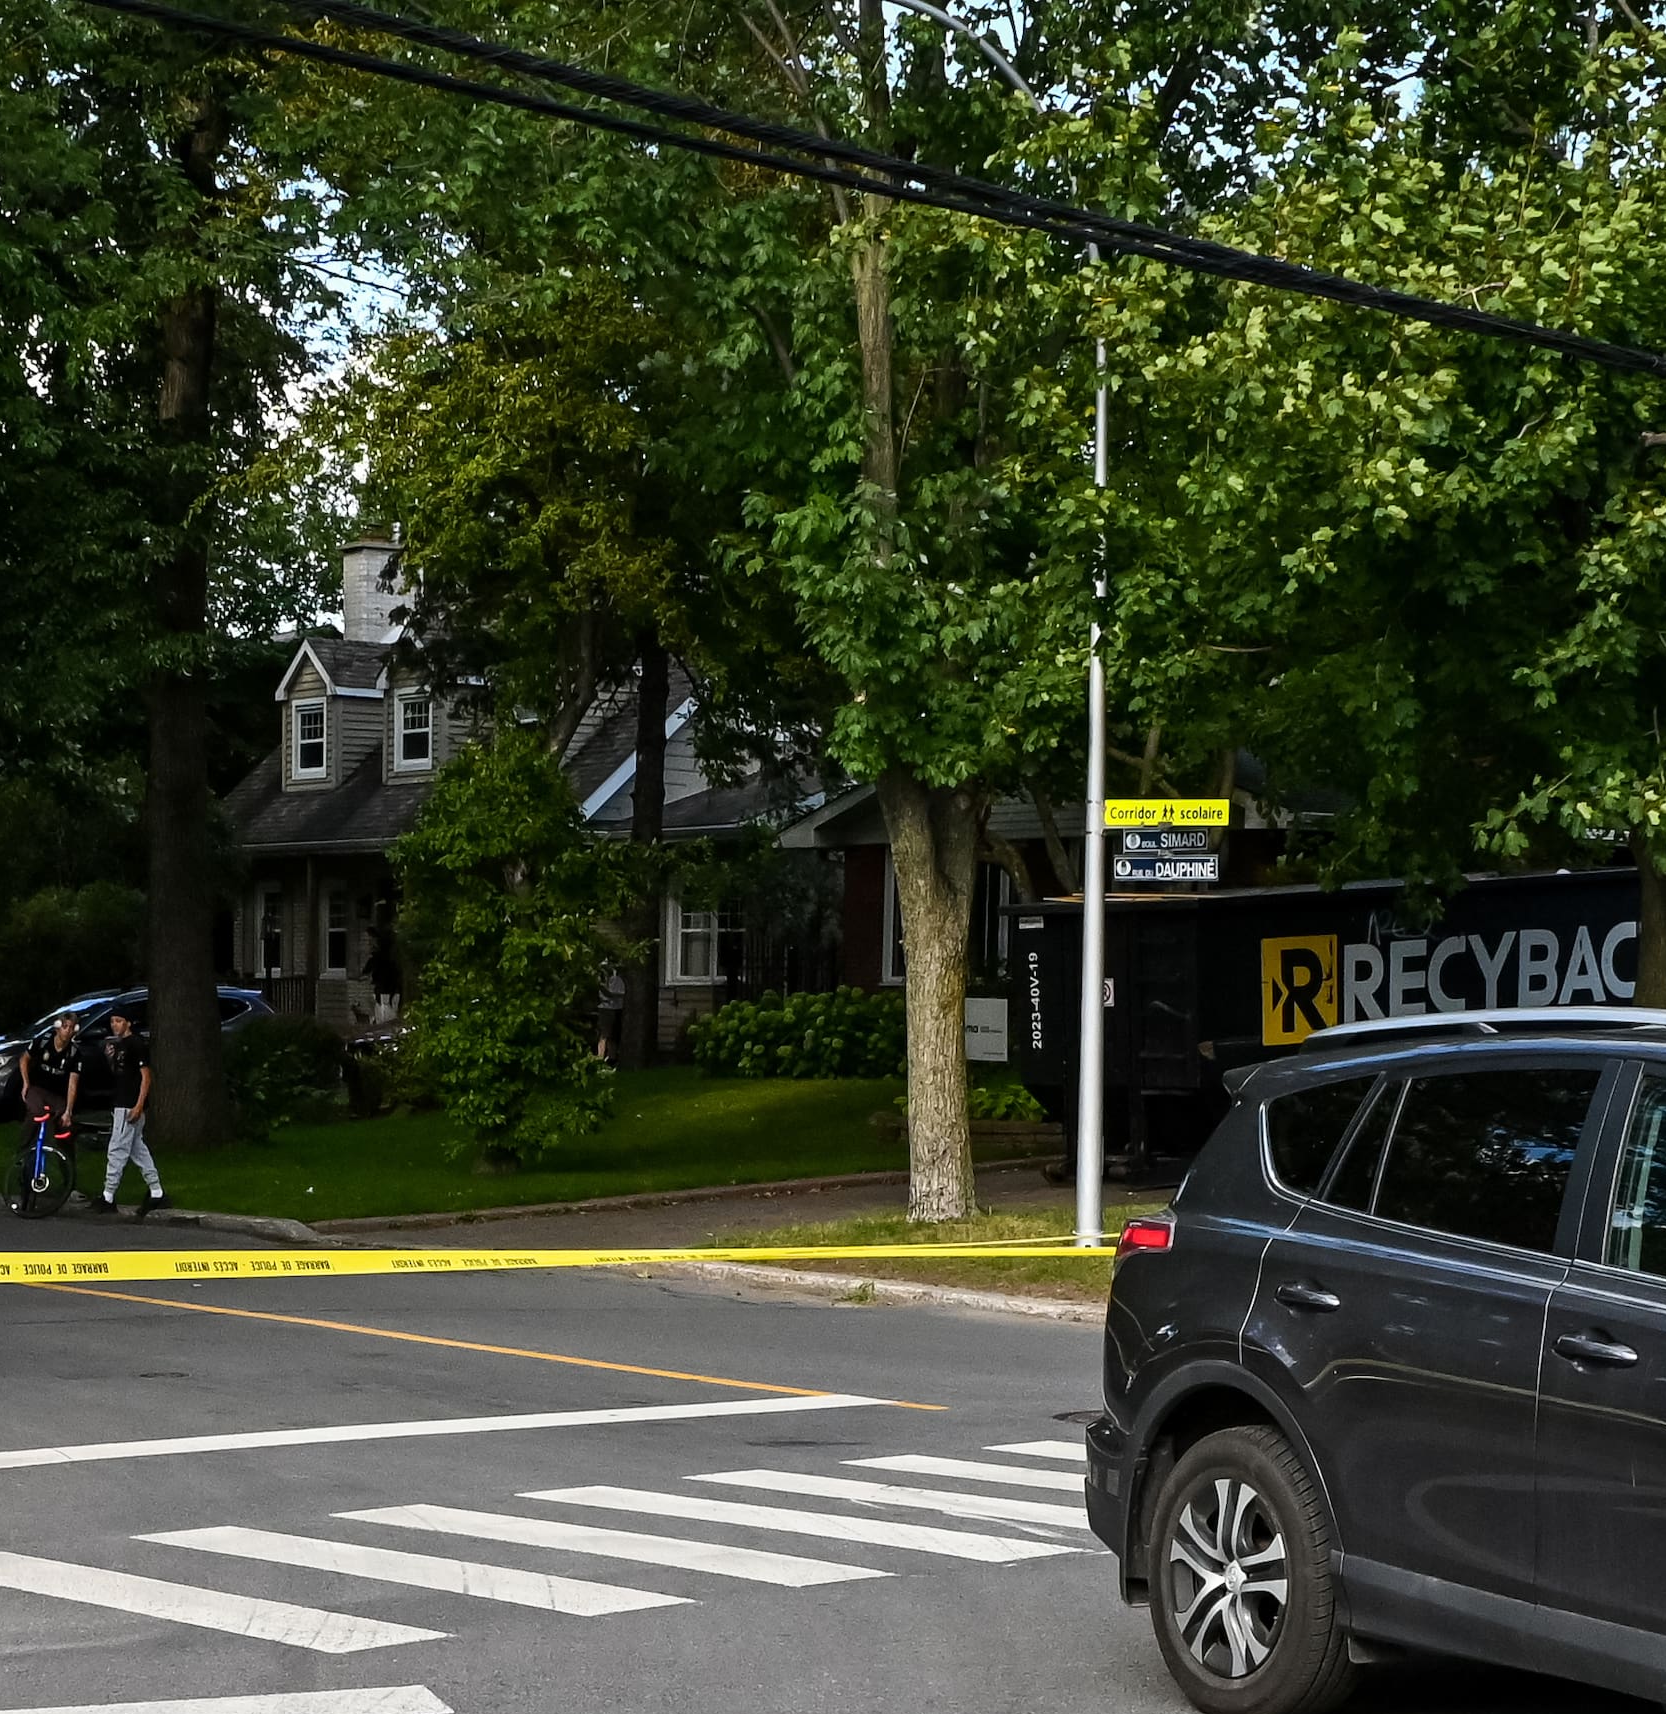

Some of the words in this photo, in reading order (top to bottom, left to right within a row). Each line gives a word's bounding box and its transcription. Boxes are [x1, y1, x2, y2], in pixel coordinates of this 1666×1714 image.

[1110, 805, 1157, 820] Corridor
[1180, 806, 1223, 820] scolaire
[1160, 832, 1206, 848] SIMARD
[1155, 857, 1215, 877] DAUPHINÉ
[1028, 952, 1043, 1049] 2023-40V-19
[23, 1263, 52, 1275] POLICE
[56, 1263, 68, 1275] DE
[72, 1262, 109, 1274] BARRAGE
